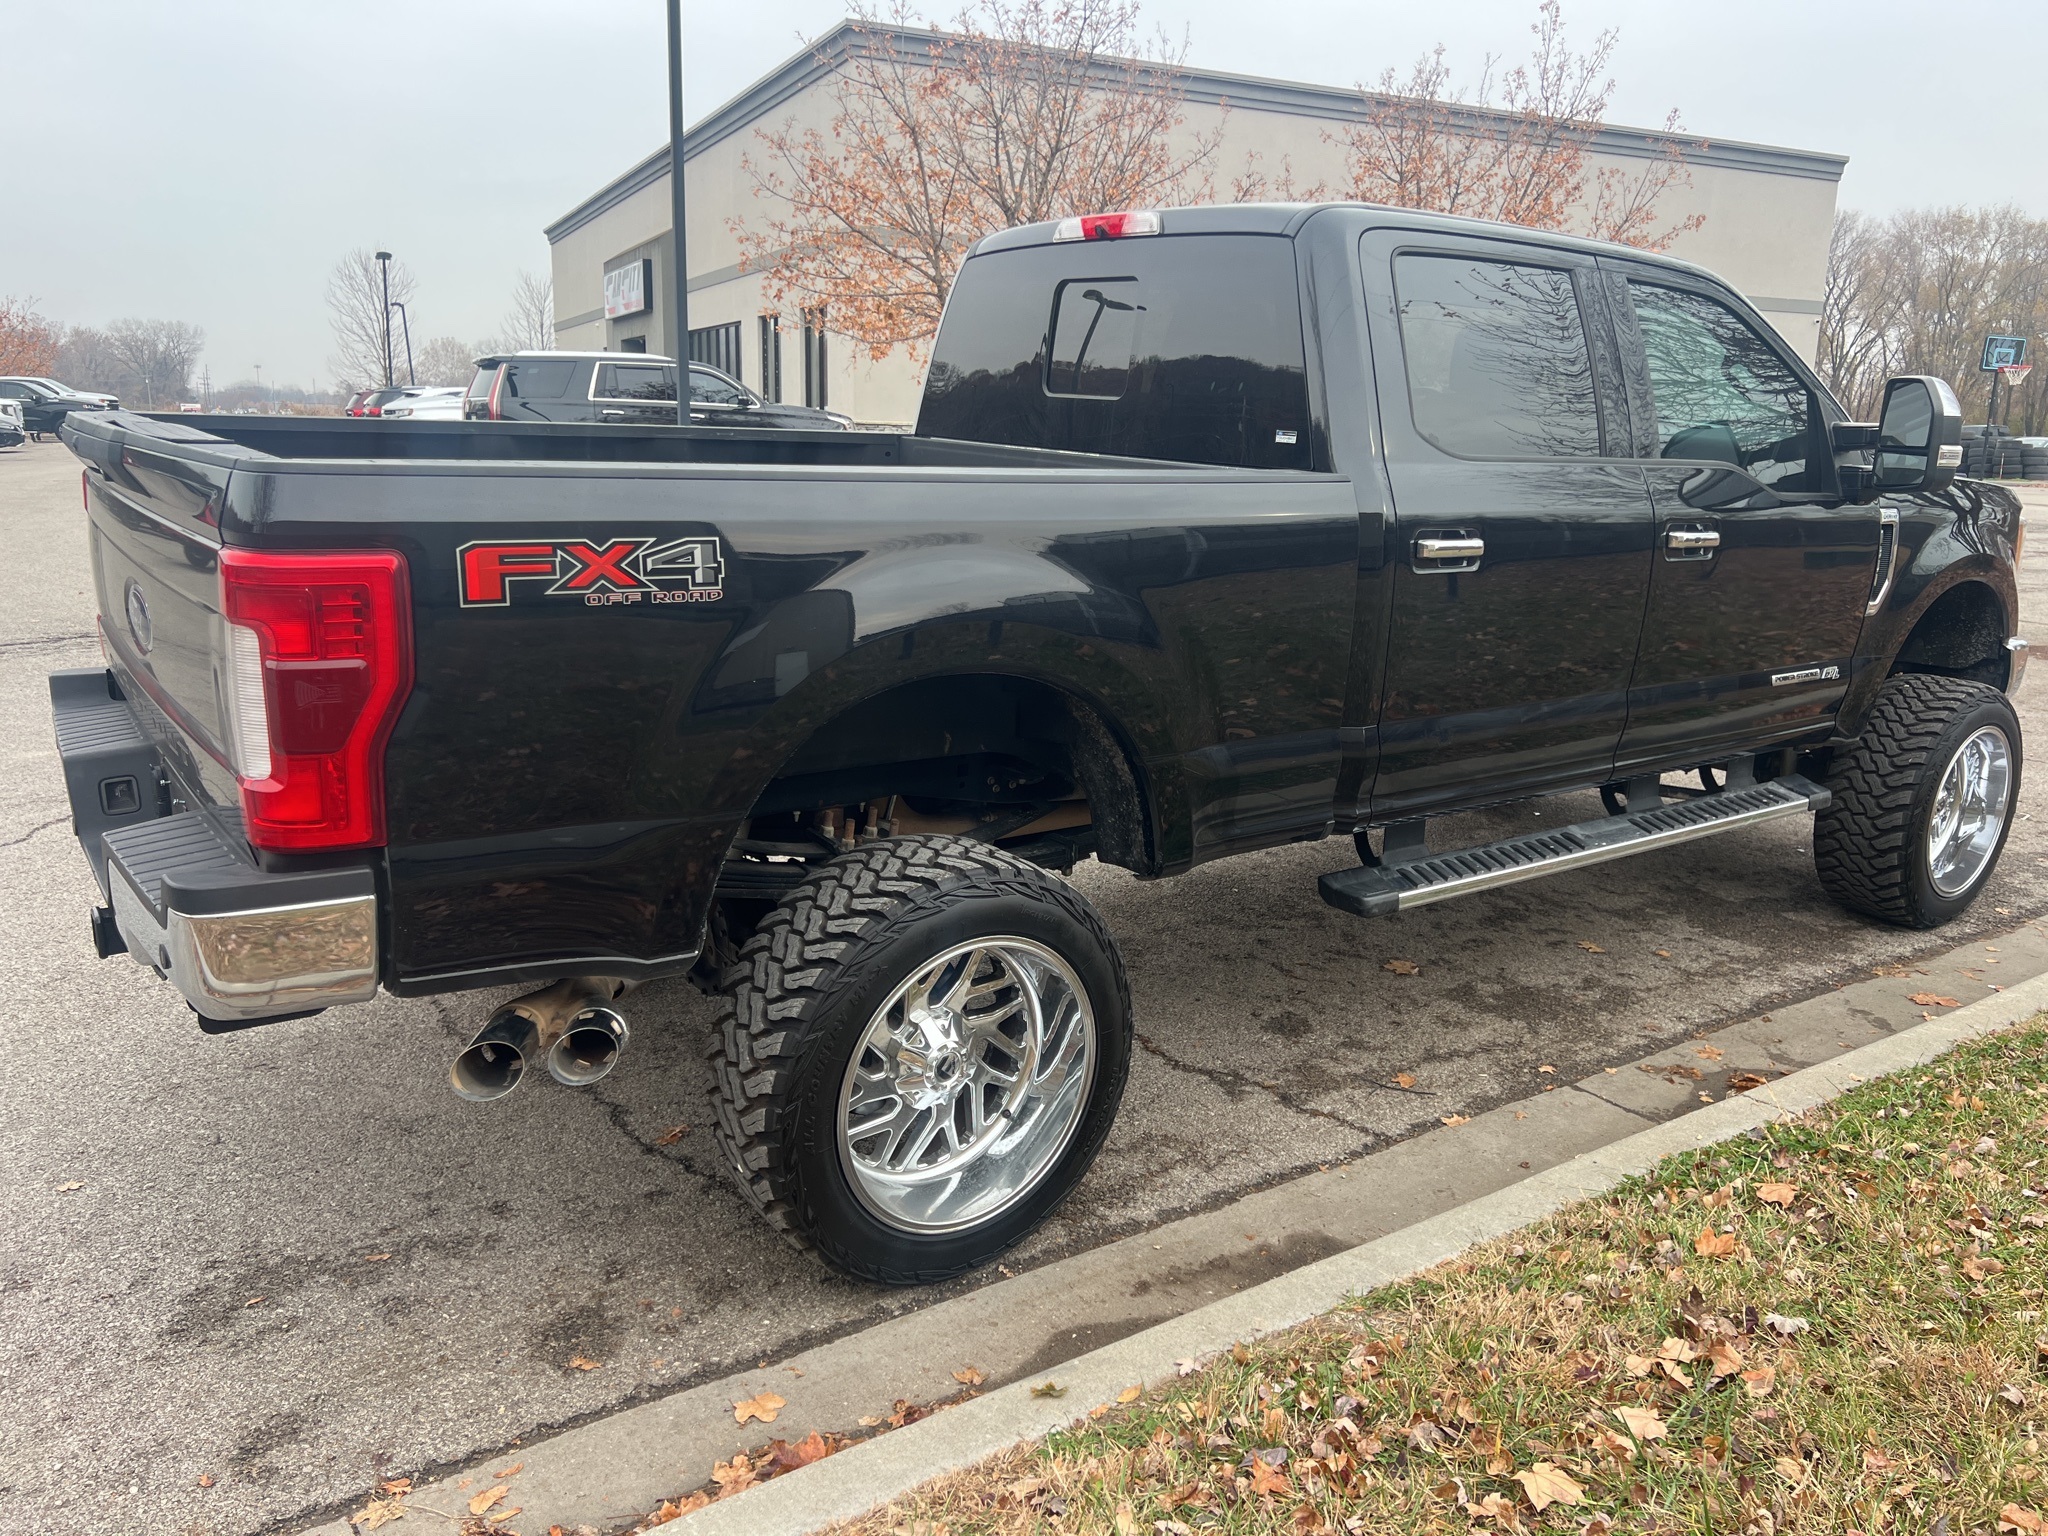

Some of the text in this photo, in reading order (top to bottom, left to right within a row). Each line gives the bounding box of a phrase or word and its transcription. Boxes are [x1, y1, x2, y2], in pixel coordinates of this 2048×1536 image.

[456, 537, 725, 608] FX4
[585, 590, 724, 606] OFF ROAD
[1775, 674, 1796, 683] POWER
[1796, 670, 1820, 680] STROKE
